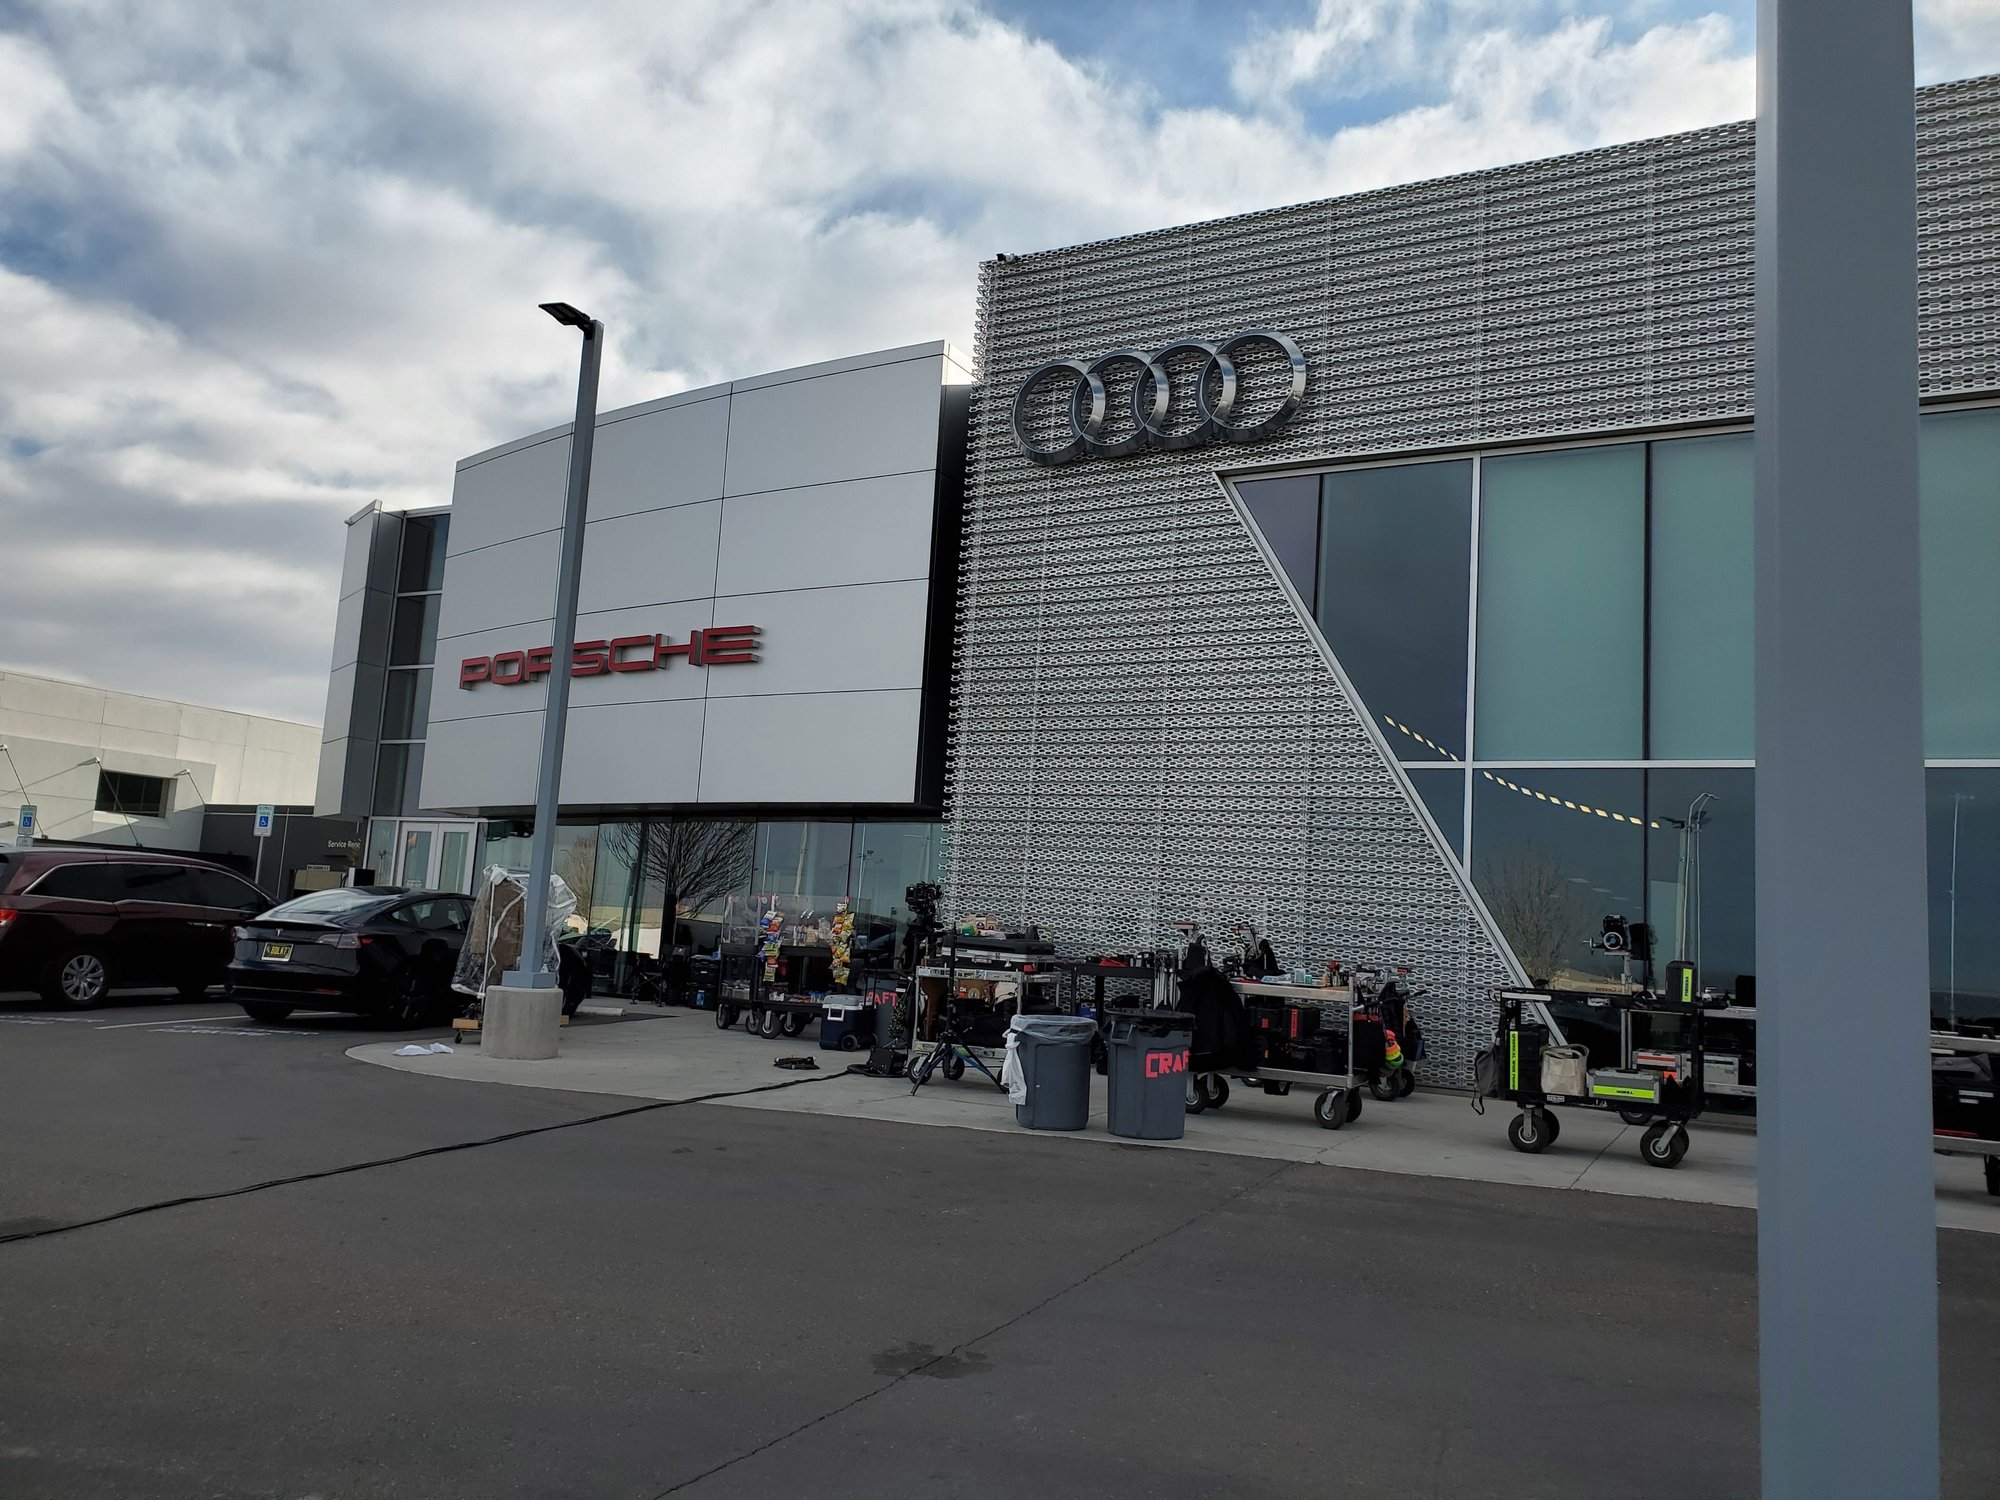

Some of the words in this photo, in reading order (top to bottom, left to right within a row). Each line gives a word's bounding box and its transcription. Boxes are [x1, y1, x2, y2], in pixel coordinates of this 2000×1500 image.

[459, 624, 762, 691] PORSCHE
[328, 840, 347, 848] Service
[1145, 1049, 1190, 1078] CRAF
